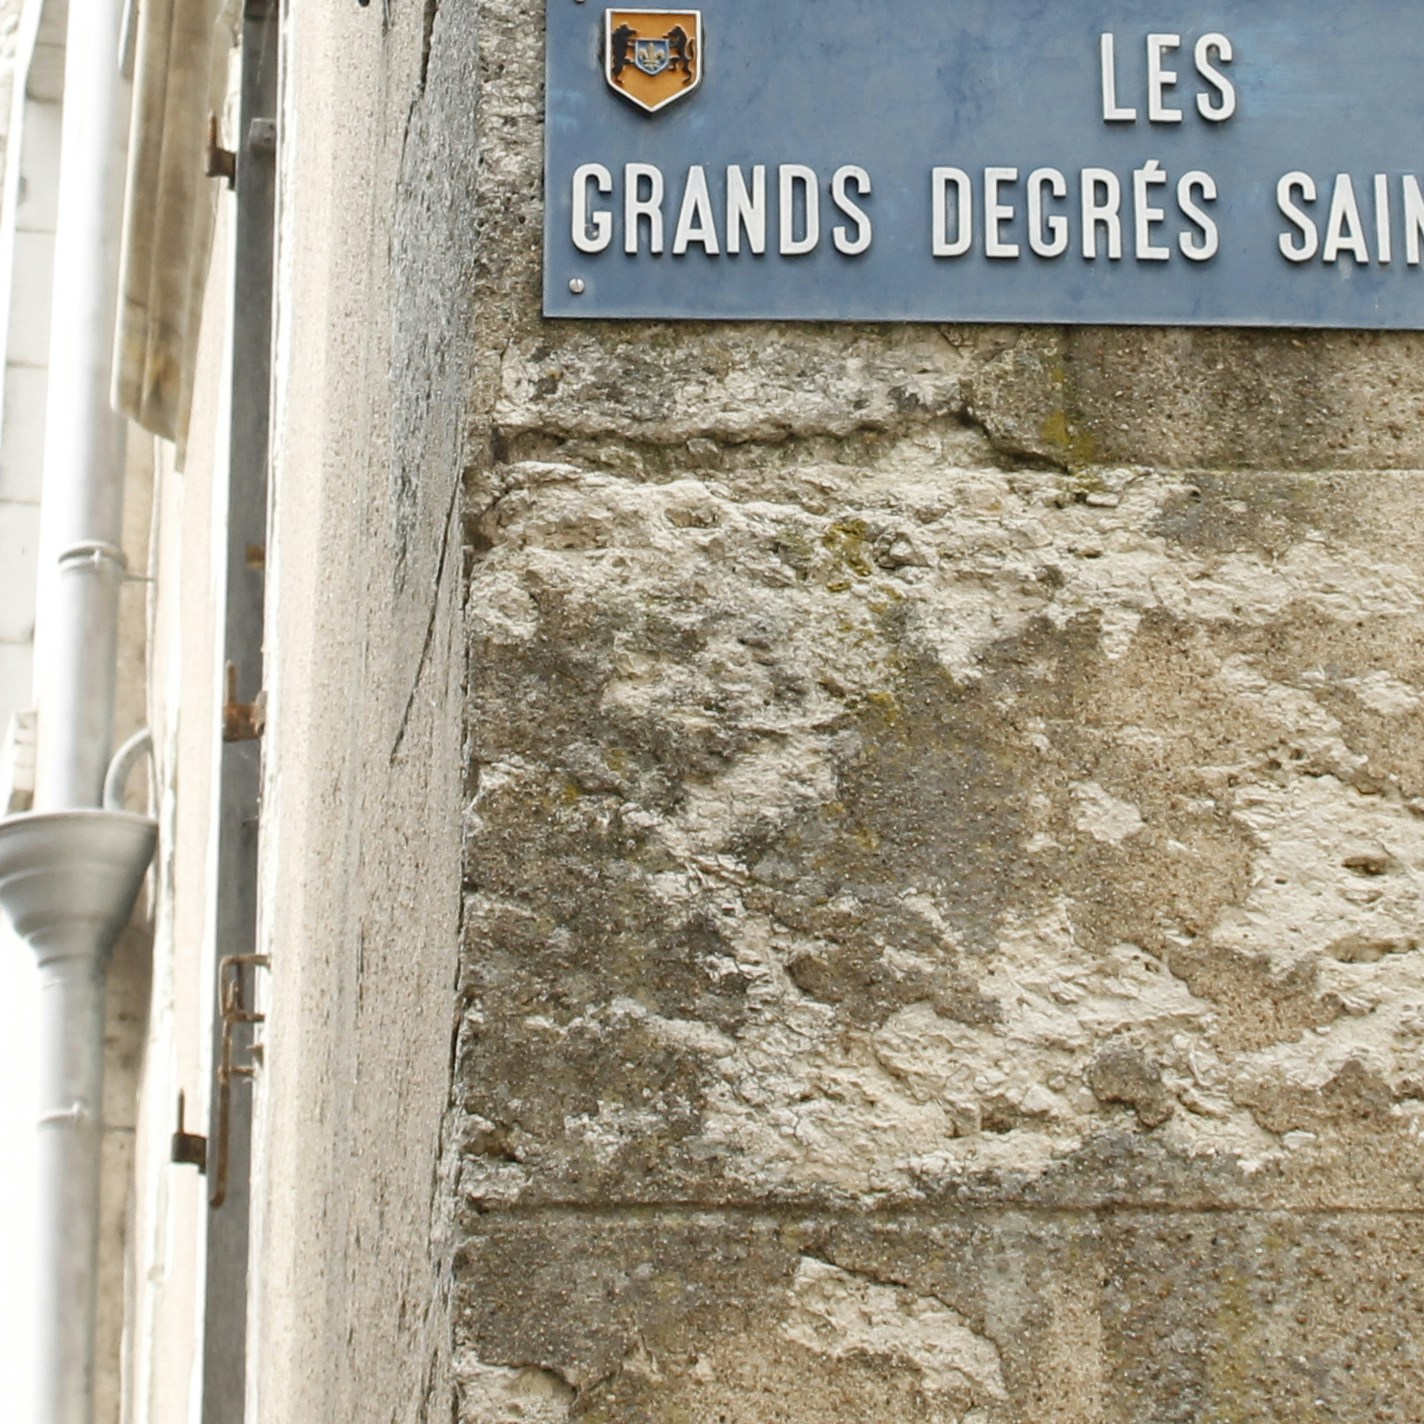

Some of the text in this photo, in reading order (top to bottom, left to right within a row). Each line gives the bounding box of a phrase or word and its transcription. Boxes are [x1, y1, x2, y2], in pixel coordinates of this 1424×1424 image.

[1100, 32, 1237, 123] LES
[571, 162, 873, 255] GRANDS
[931, 159, 1220, 261] DEGRÉS
